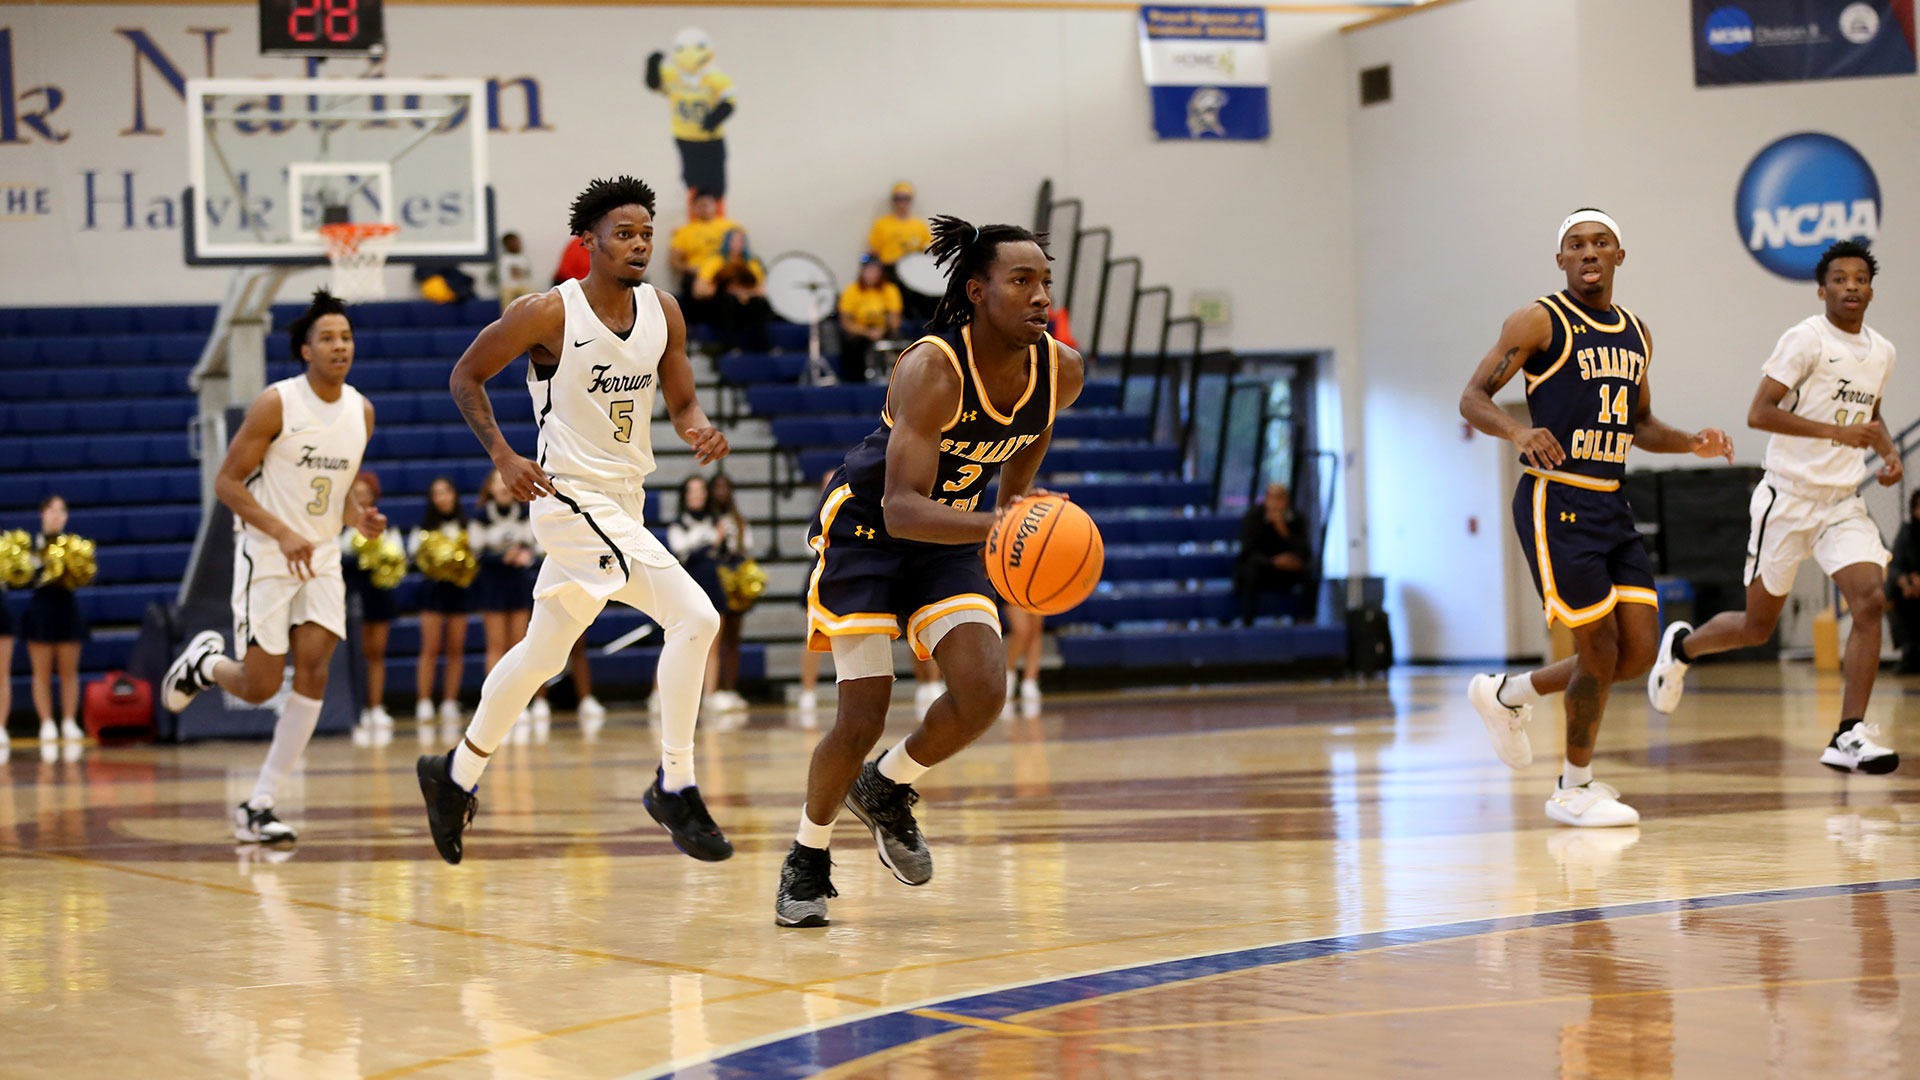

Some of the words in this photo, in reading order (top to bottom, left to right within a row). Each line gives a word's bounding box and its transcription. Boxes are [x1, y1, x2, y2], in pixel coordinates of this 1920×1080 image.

[287, 0, 359, 42] 28
[0, 187, 51, 216] HE
[1751, 199, 1879, 250] NCAA
[587, 364, 652, 394] Ferrum
[1831, 378, 1875, 406] Ferrum
[609, 399, 634, 444] 5
[1597, 383, 1629, 426] 14
[295, 445, 351, 471] Ferrum
[943, 463, 983, 493] 3
[306, 475, 333, 516] 3
[1008, 501, 1053, 569] Wilson
